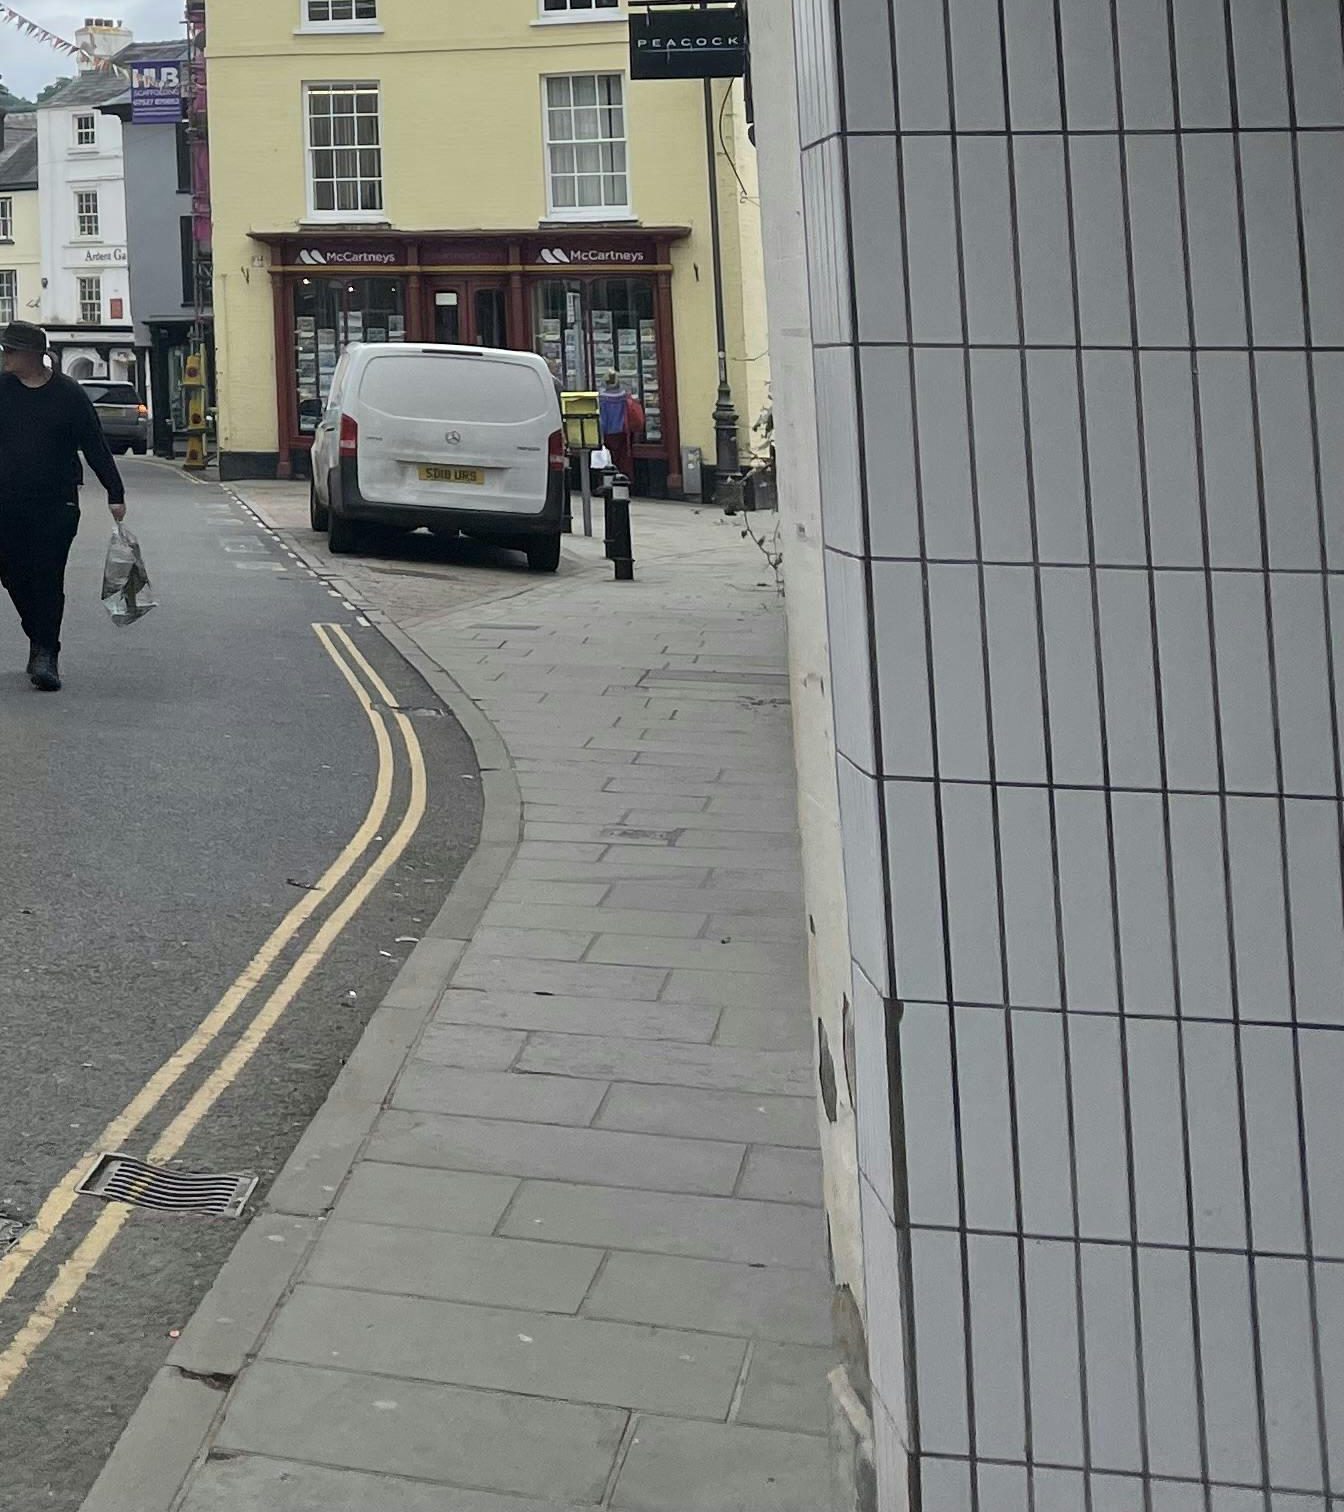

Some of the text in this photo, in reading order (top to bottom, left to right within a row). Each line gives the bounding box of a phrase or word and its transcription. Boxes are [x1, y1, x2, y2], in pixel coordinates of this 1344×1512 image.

[637, 36, 747, 48] PEACOCK
[326, 251, 396, 264] McCartneys
[570, 249, 644, 263] McCartneys
